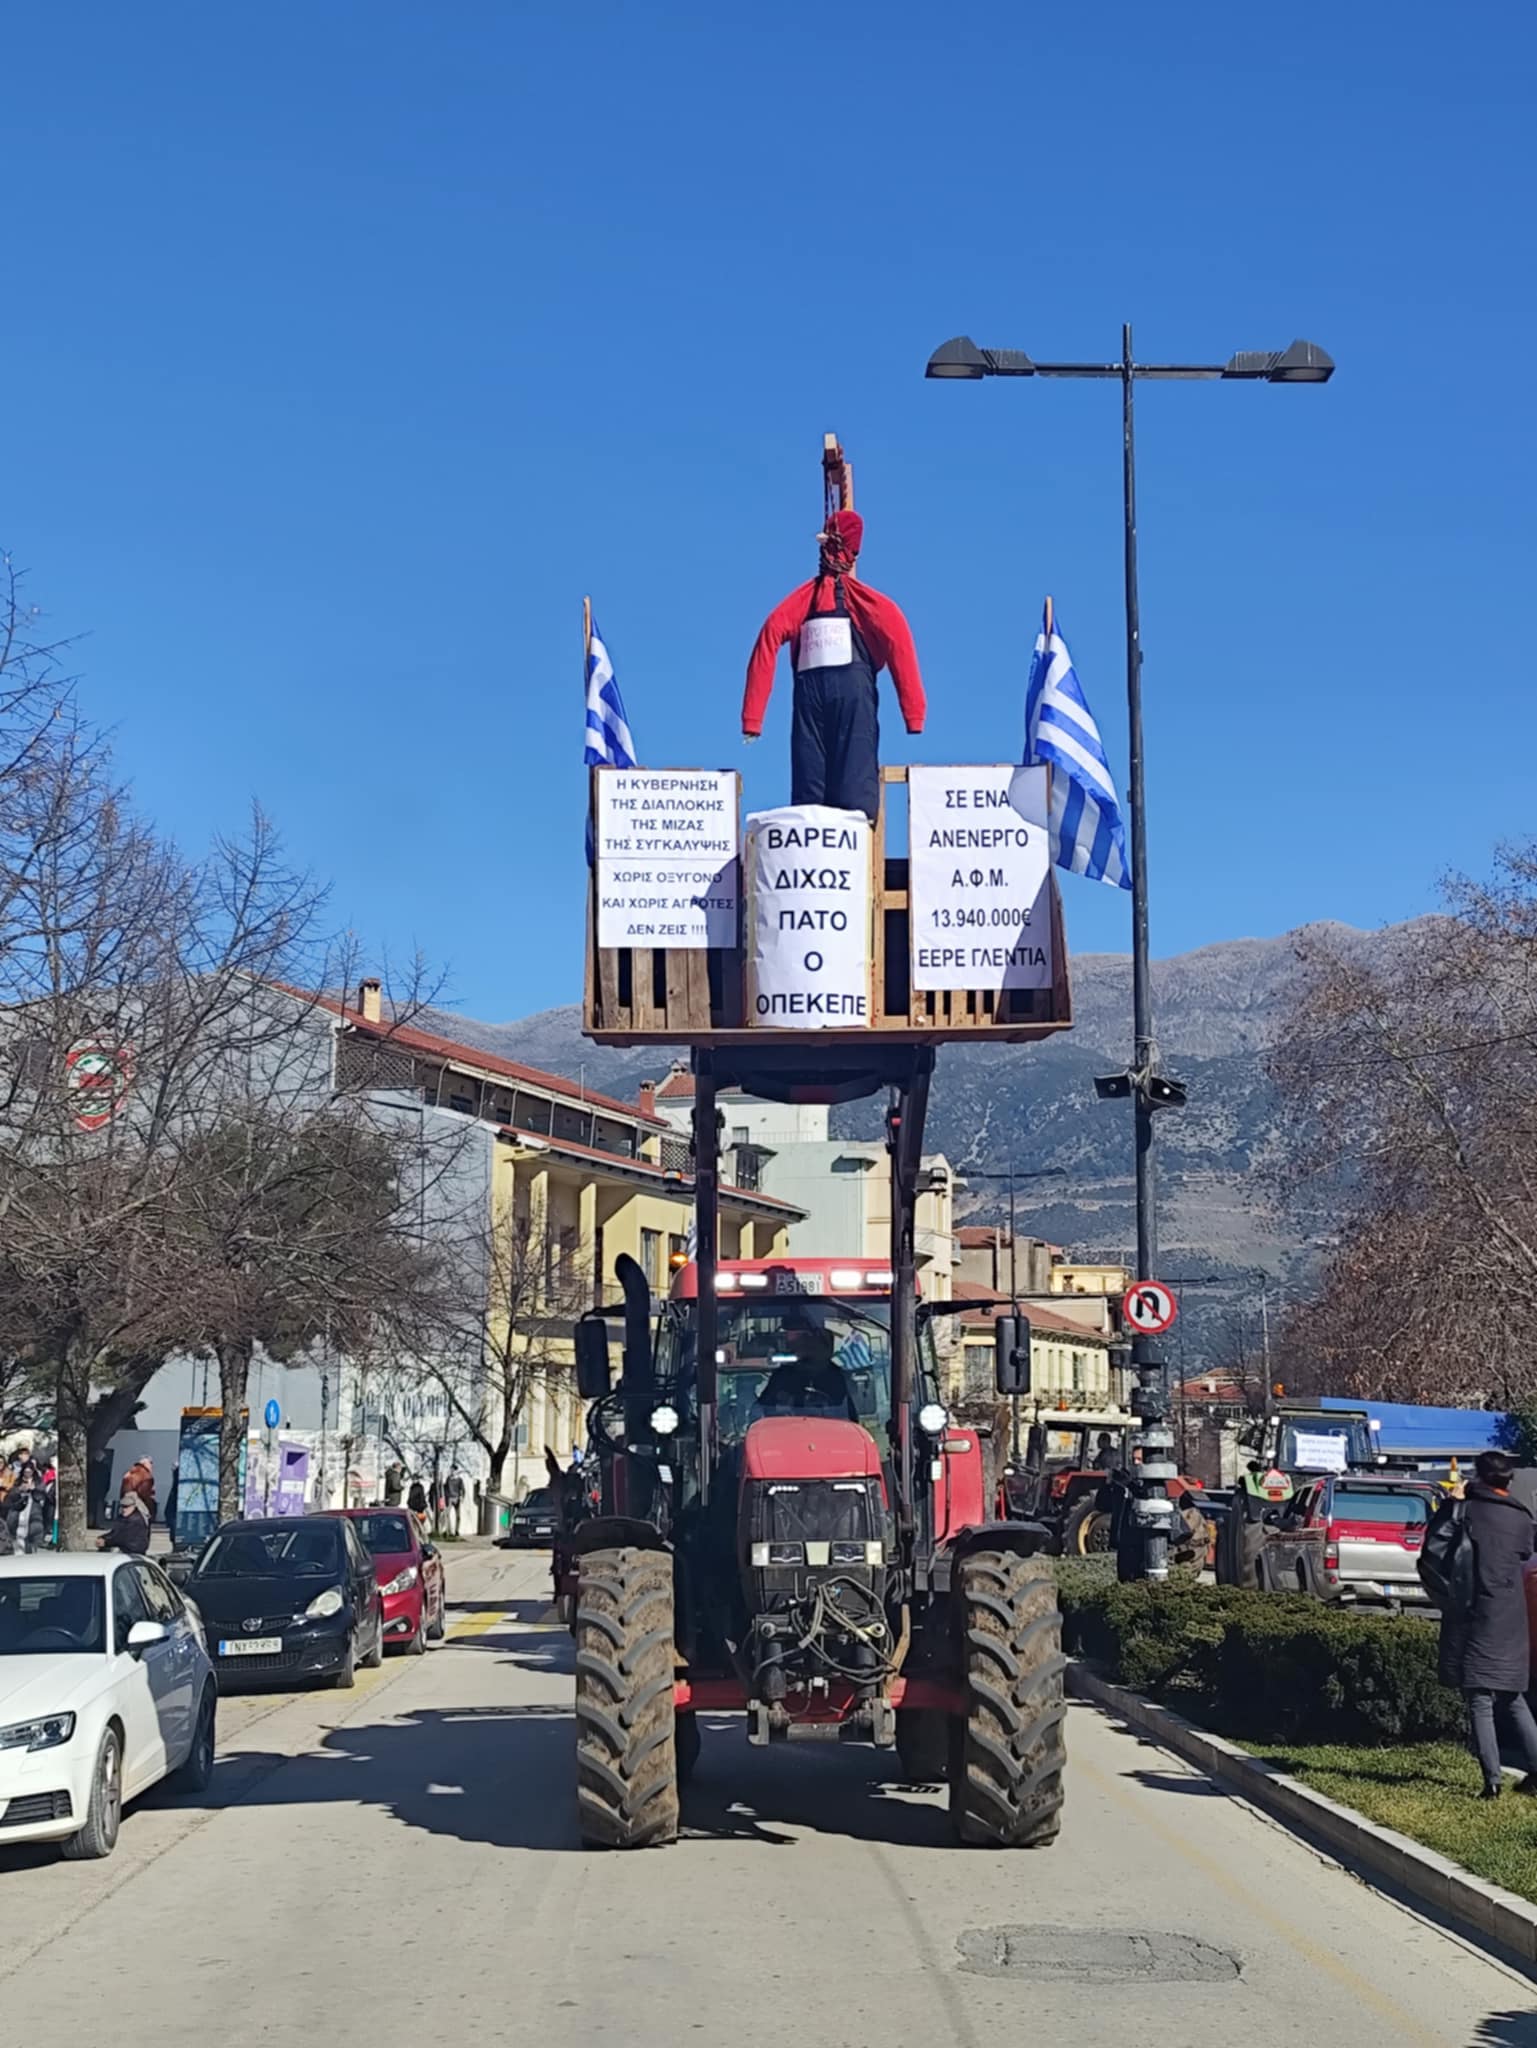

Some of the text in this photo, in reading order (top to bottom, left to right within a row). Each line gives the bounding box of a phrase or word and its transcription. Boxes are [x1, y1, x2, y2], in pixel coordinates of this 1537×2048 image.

[617, 779, 718, 791] Η ΚΥΒΕΡΝΗΣΗ
[611, 798, 725, 812] ΤΗΣ ΔΙΑΠΛΟΚΗΣ
[945, 789, 1011, 809] ΣΕ ΕΝΑ
[631, 819, 704, 831] ΤΗΣ ΜΙΖΑΣ
[605, 838, 731, 852] ΤΗΣ ΣΥΓΚΑΛΥΨΗΣ
[768, 827, 857, 850] ΒΑΡΕΛΙ
[929, 828, 1029, 848] ΑΝΕΝΕΡΓΟ
[613, 871, 723, 884] ΧΩΡΙΣ ΟΞΥΓΟΝΟ
[774, 868, 852, 891] ΔΙΧΩΣ
[951, 868, 1009, 888] Α.Φ.Μ.
[602, 897, 734, 911] ΚΑΙ ΧΩΡΙΣ ΑΓΡΟΤΕΣ
[778, 909, 848, 932] ΠΑΤΟ
[931, 907, 1032, 928] 13.940.000€
[627, 924, 655, 935] ΔΕΝ
[658, 924, 688, 935] ΖΕΙΣ
[803, 950, 824, 972] Ο
[918, 947, 1047, 968] ΕΕΡΕ ΓΛΕΝΤΙΑ
[756, 993, 867, 1016] ΟΠΕΚΕΠΕ
